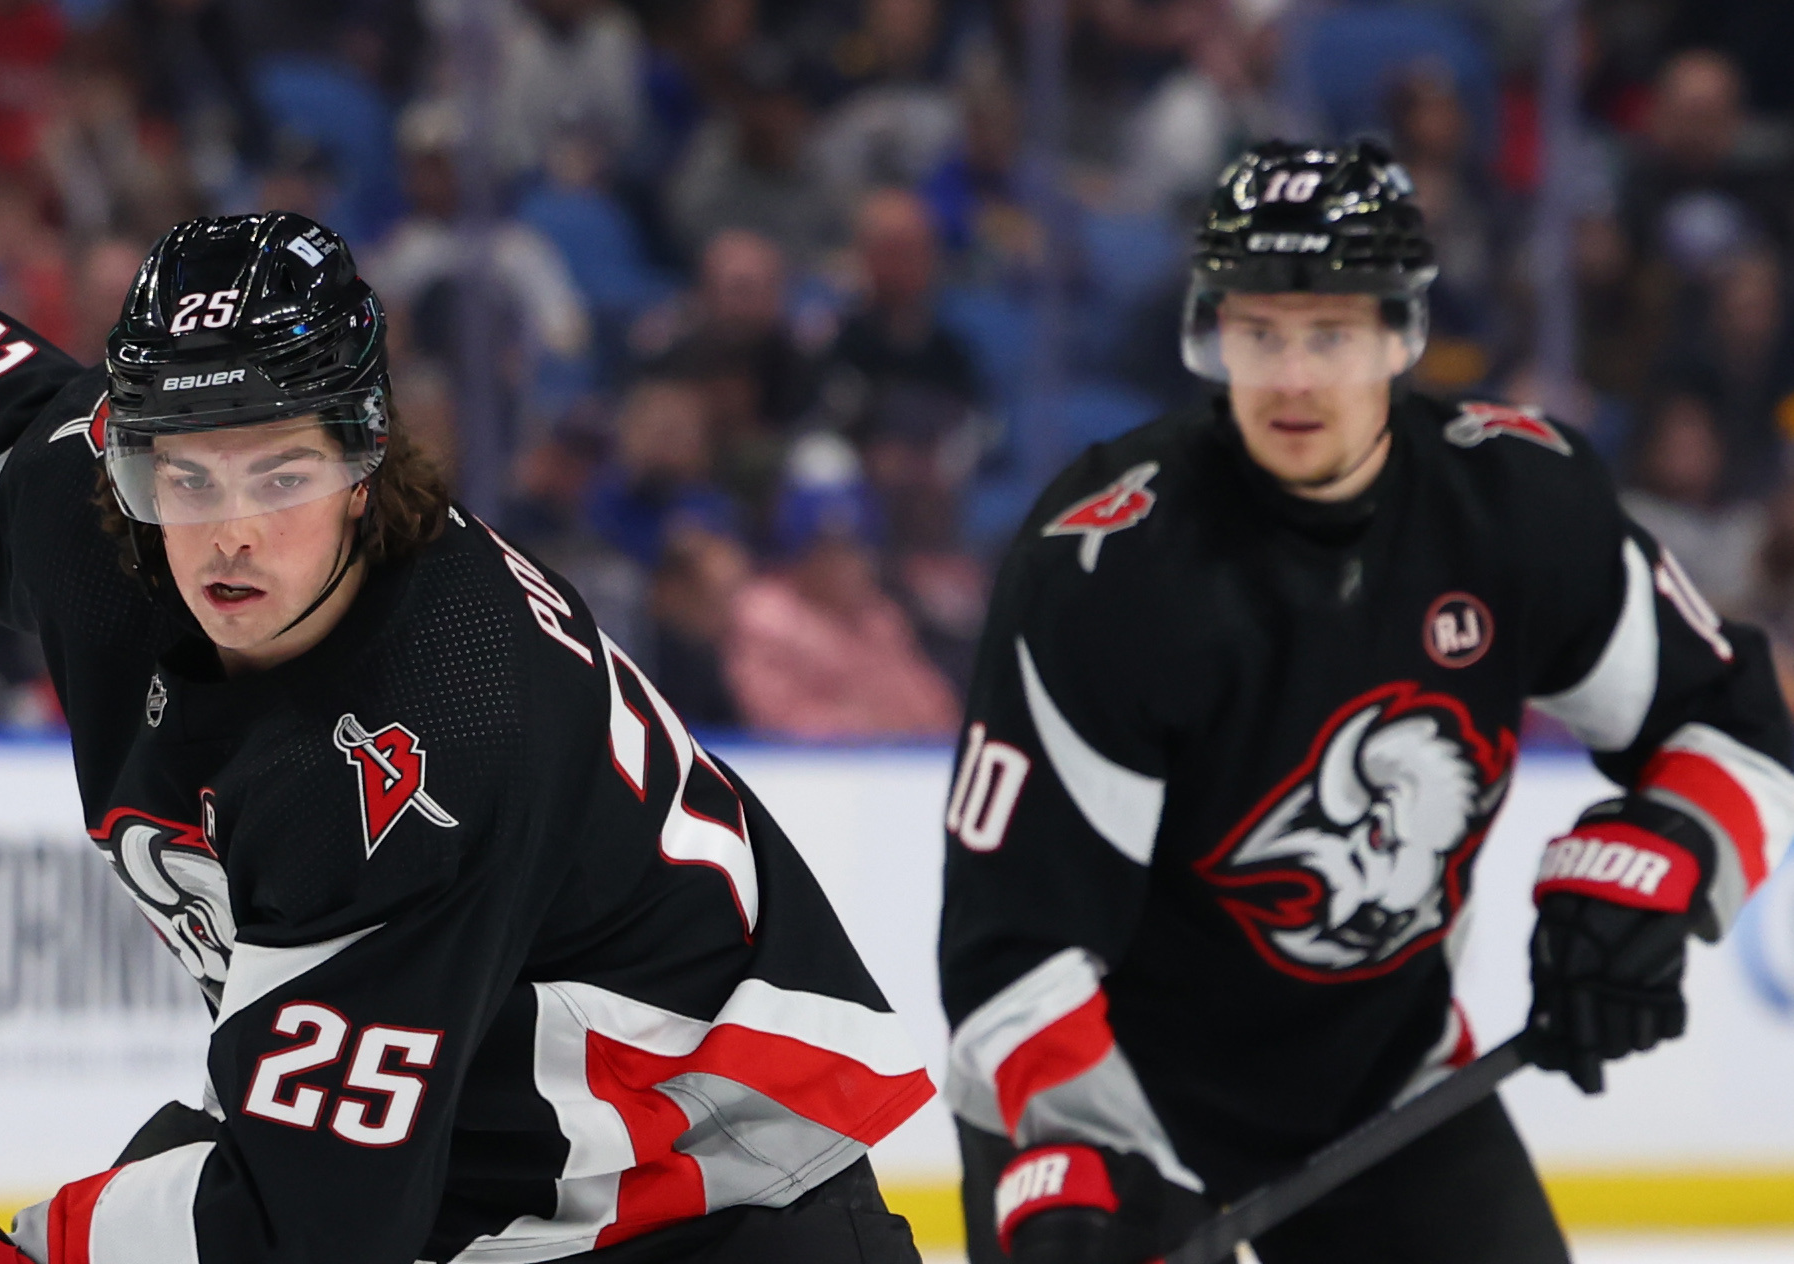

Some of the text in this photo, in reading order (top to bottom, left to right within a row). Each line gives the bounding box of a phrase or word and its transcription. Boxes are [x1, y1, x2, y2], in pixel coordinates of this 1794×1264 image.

[1262, 170, 1322, 202] 10
[1247, 232, 1331, 253] CCM
[169, 289, 240, 333] 25
[163, 369, 245, 391] BAUER
[1433, 607, 1482, 654] RJ
[592, 622, 758, 945] 2
[946, 720, 1033, 853] 10
[241, 999, 444, 1147] 25
